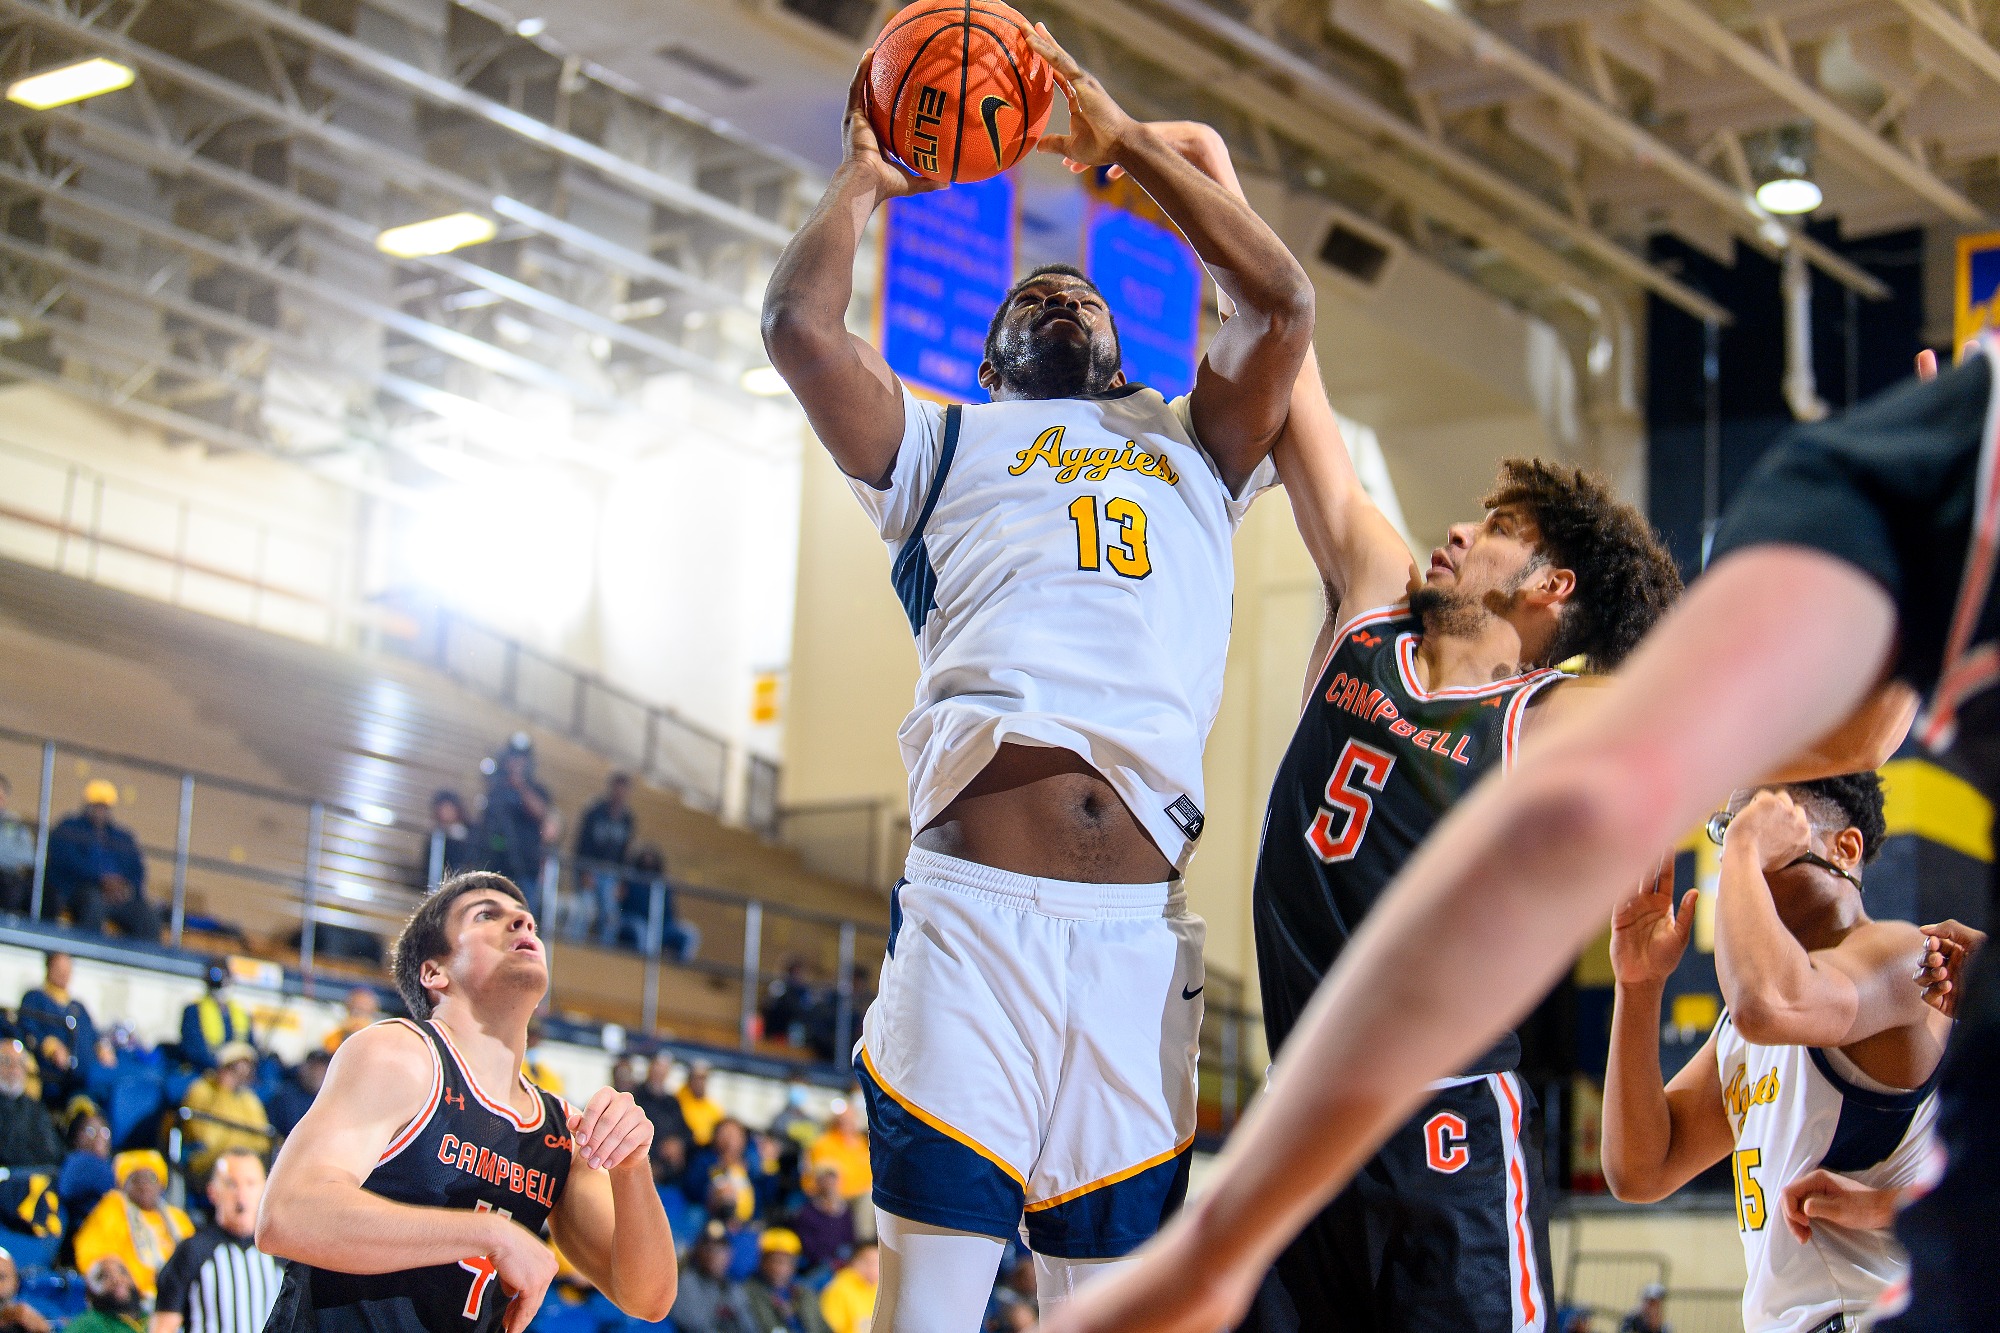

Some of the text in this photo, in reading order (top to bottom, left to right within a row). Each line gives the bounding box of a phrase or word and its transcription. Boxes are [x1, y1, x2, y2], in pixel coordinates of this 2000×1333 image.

[911, 85, 947, 173] ELITE
[1008, 426, 1180, 486] Aggies
[1068, 495, 1152, 580] 13
[1325, 672, 1471, 766] CAMPBELL
[1305, 736, 1397, 864] 5
[437, 1133, 556, 1208] CAMPBELL
[1423, 1112, 1470, 1174] C
[1732, 1147, 1767, 1232] 15
